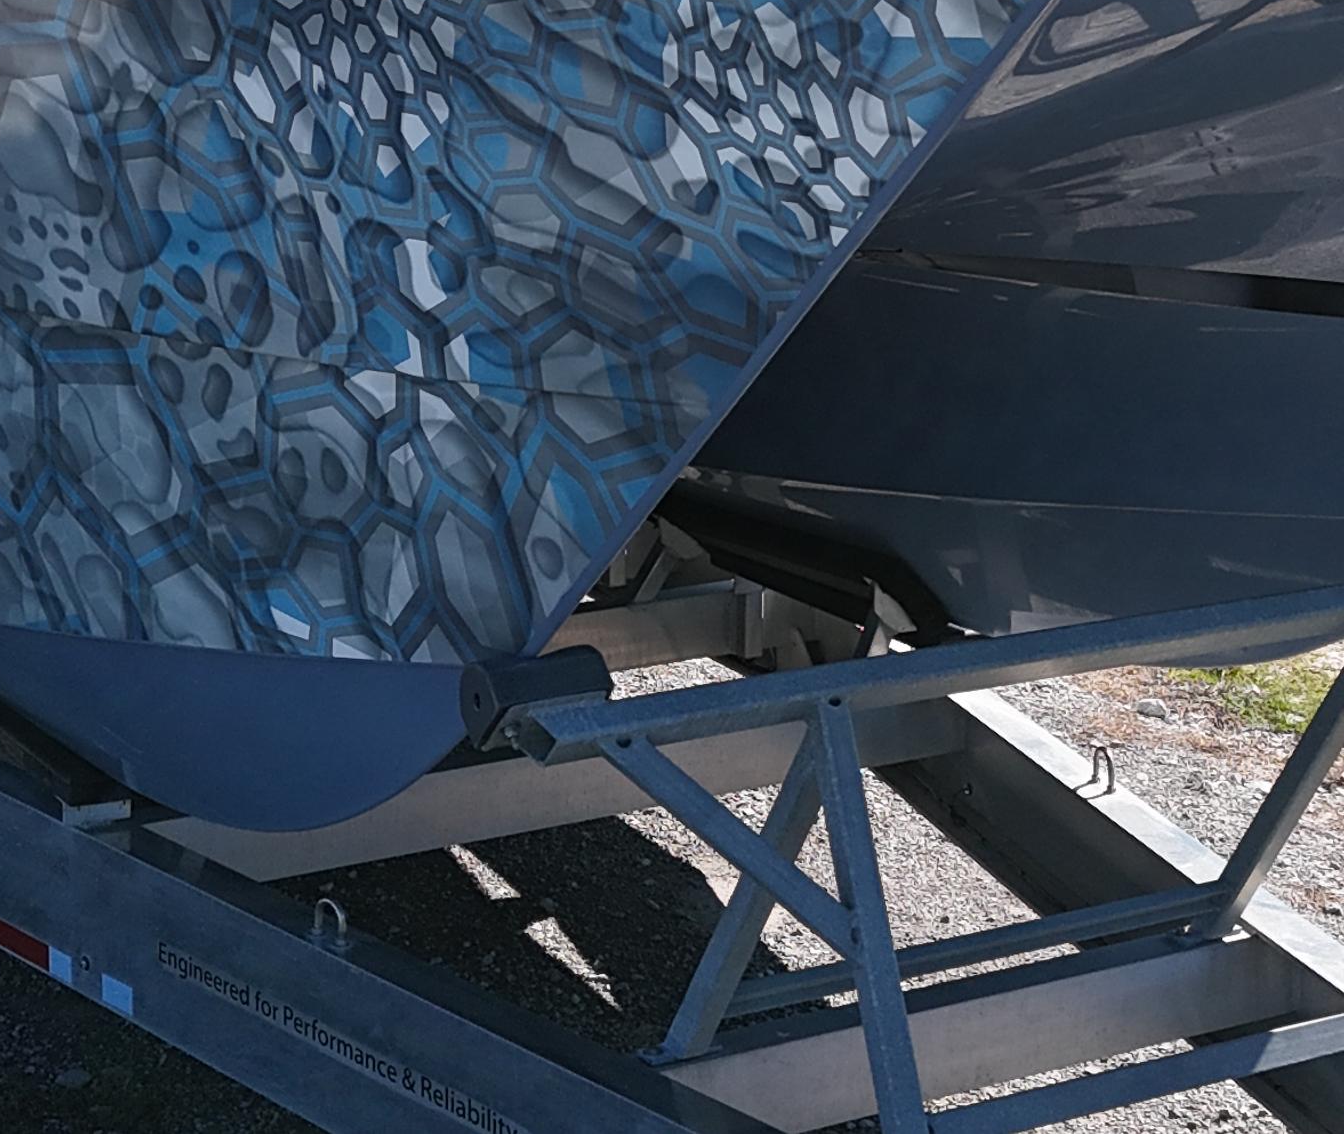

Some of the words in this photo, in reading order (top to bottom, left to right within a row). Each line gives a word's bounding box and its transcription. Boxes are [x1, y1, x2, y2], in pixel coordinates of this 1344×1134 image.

[158, 943, 250, 1006] Engineered
[255, 990, 279, 1020] for
[283, 1005, 398, 1083] Performance
[402, 1067, 416, 1094] &
